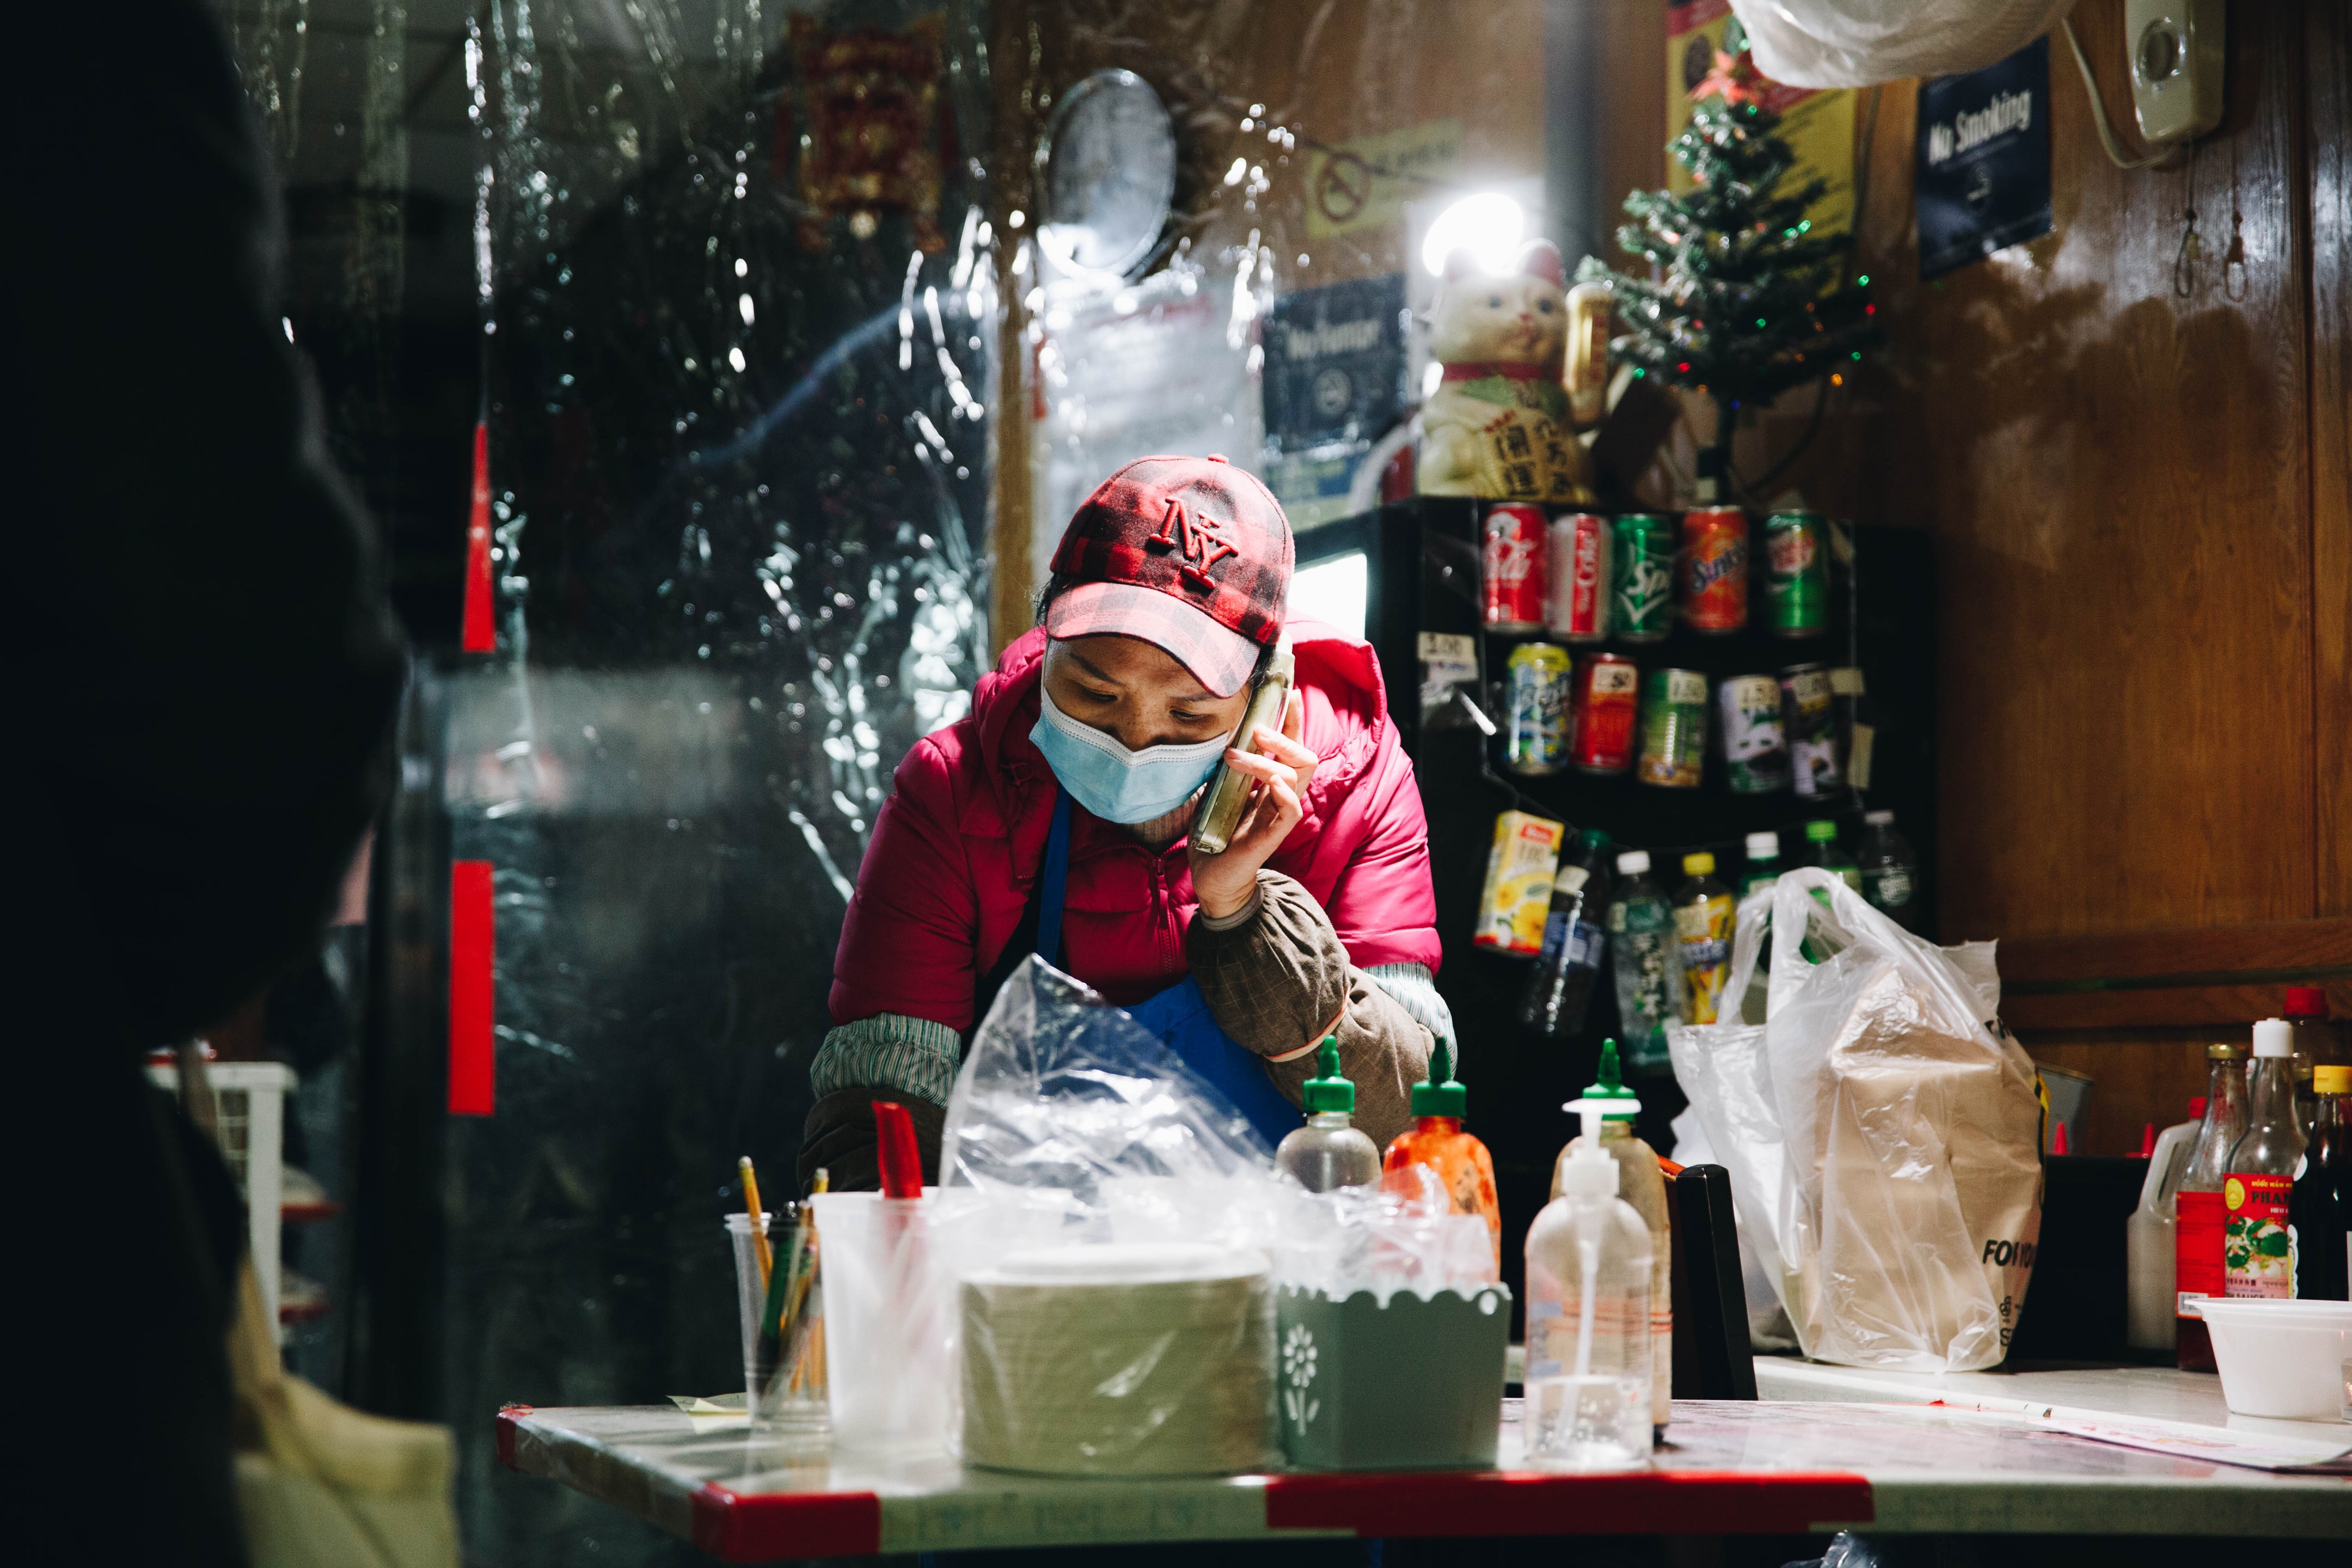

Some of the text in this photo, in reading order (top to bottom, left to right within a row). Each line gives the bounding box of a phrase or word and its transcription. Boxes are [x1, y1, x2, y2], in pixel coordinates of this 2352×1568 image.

[1928, 121, 1954, 166] No
[1956, 88, 2032, 153] Smoking
[1148, 496, 1240, 589] NY
